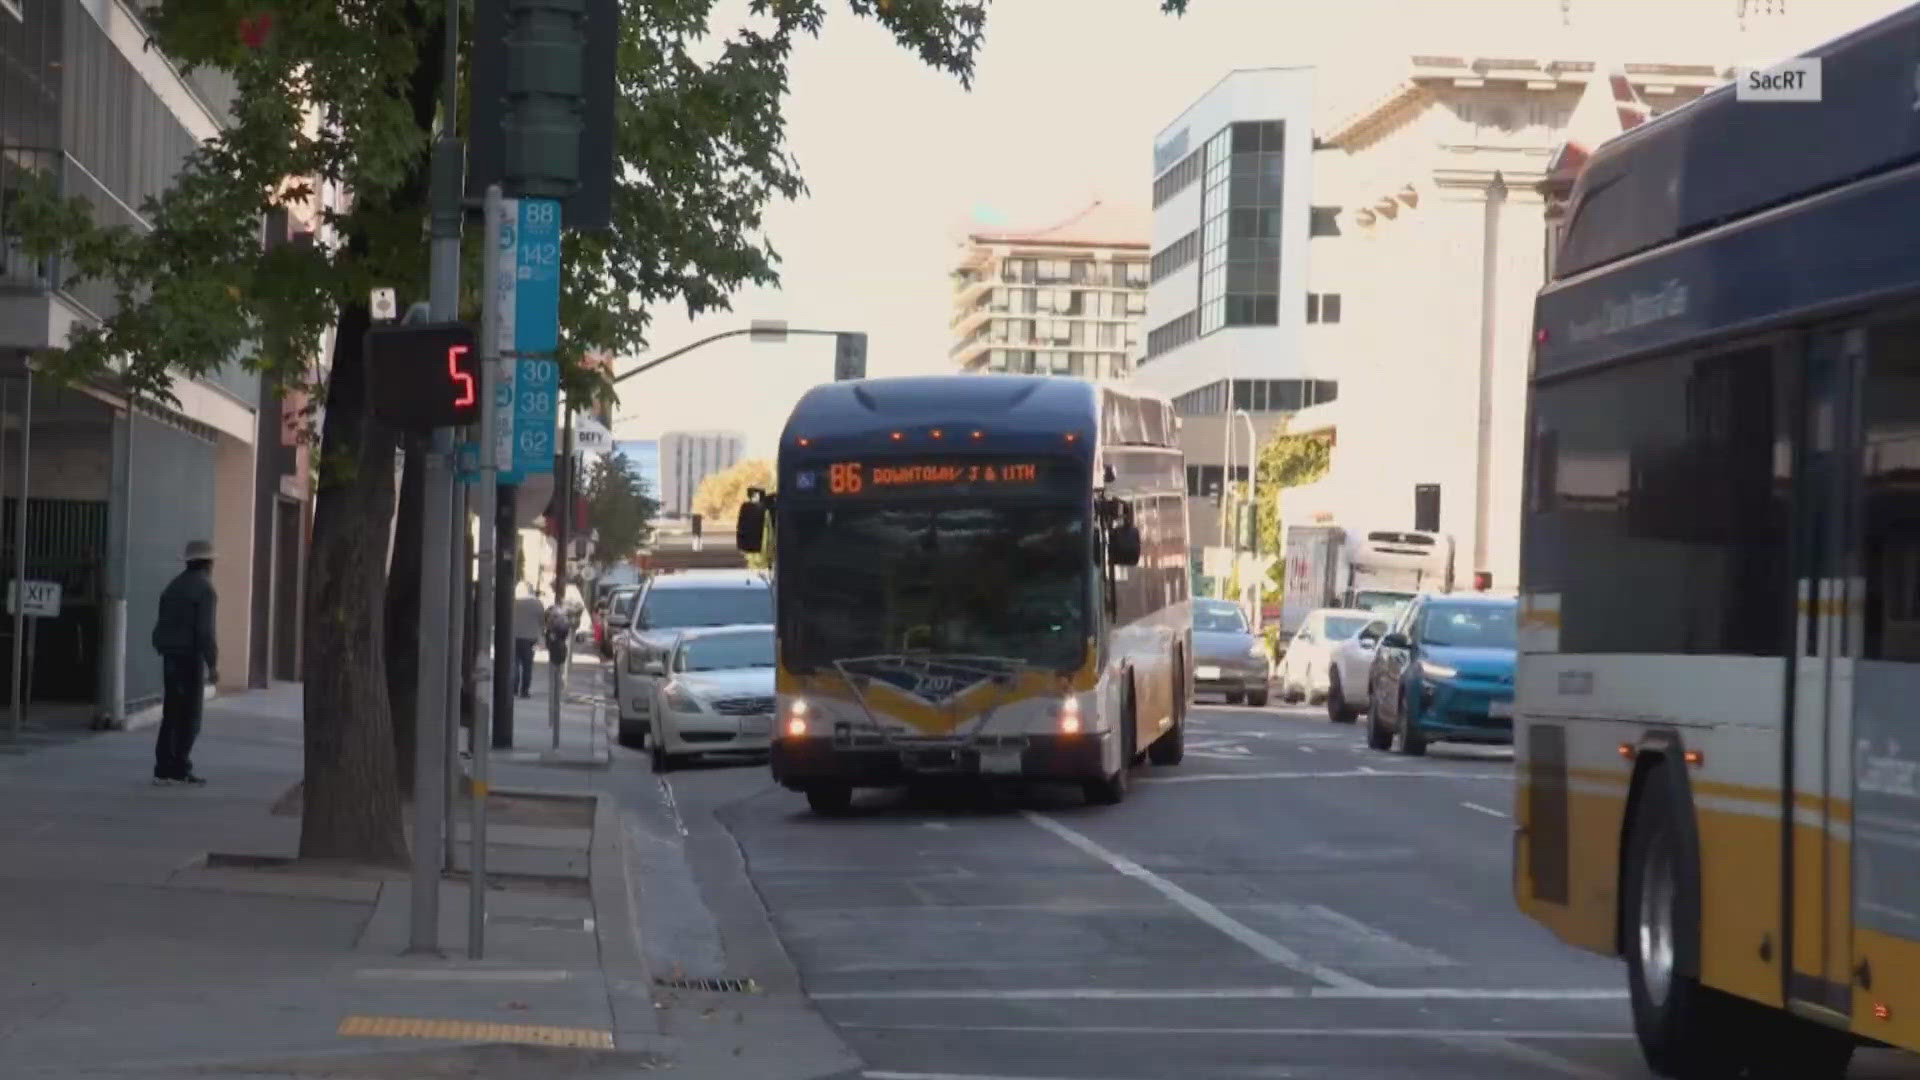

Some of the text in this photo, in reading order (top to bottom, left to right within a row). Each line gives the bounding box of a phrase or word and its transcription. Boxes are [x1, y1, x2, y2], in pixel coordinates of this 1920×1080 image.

[527, 203, 553, 224] 88
[522, 244, 556, 264] 142
[448, 344, 475, 406] 5
[523, 360, 551, 381] 30
[521, 391, 549, 412] 38
[520, 430, 547, 452] 62
[830, 463, 862, 493] 86
